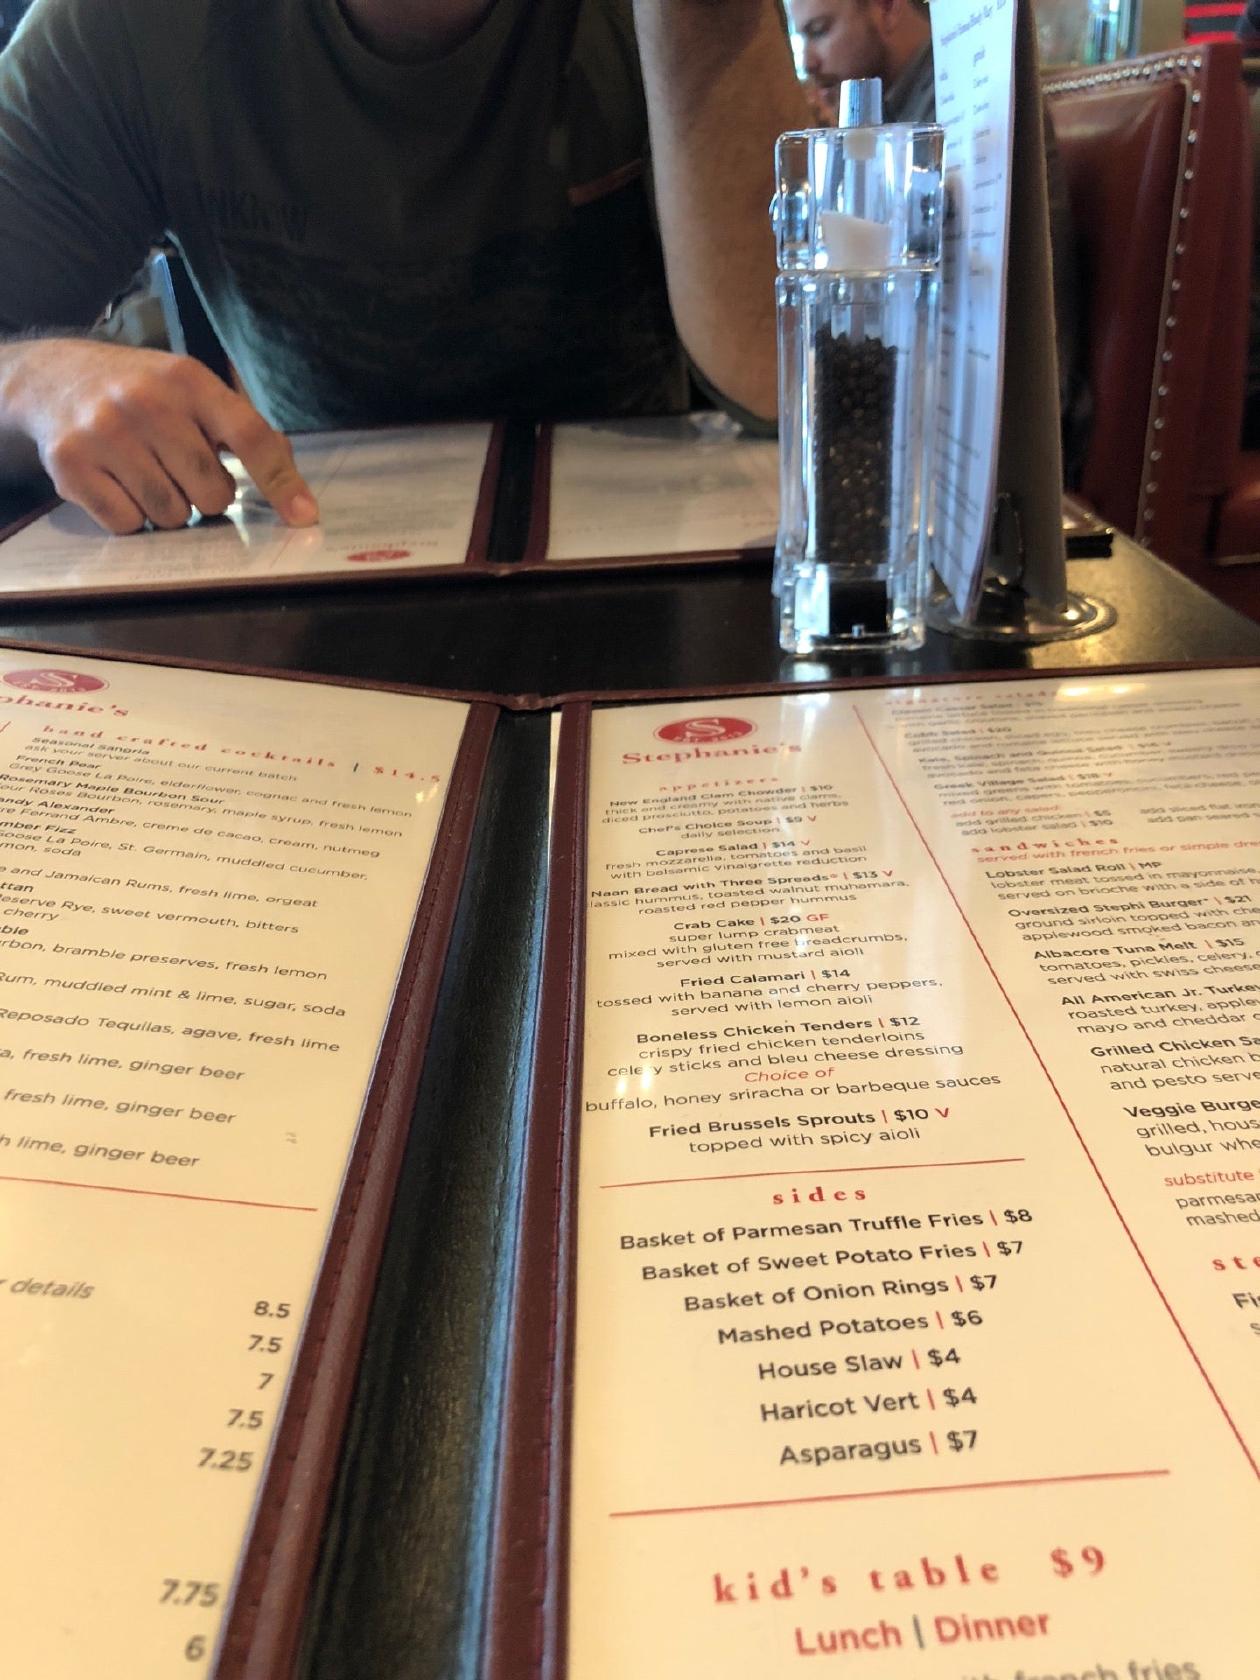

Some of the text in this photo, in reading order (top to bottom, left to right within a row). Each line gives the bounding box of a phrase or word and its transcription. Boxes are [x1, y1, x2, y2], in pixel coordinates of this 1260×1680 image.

[43, 725, 103, 738] hand
[116, 736, 207, 751] crafted
[16, 755, 65, 766] French
[622, 743, 801, 764] Stephanie's
[0, 773, 222, 804] Rosemary Maple Bourbon Sour
[685, 822, 732, 830] Choice
[656, 847, 714, 856] Caprese
[718, 843, 758, 851] Salad
[971, 838, 1118, 852] sandwiches
[985, 861, 1162, 878] Lobster Salad Roll MP
[10, 868, 317, 907] and Jamaican Rums, fresh lime, orgeat
[634, 884, 677, 894] Bread
[683, 881, 715, 890] with
[852, 871, 878, 879] $13
[60, 900, 95, 913] Rye,
[101, 907, 150, 918] sweet
[157, 913, 239, 927] vermouth,
[245, 920, 298, 933] bitters
[1008, 905, 1089, 917] Oversized
[1093, 901, 1145, 912] Stephi
[1224, 895, 1251, 904] $21
[673, 913, 828, 930] Crab Cake $20 GF
[1034, 938, 1244, 959] Albacore Tuna Melt $15
[680, 969, 850, 987] Fried Calamari $14
[44, 979, 127, 993] muddled
[130, 987, 172, 998] mint
[177, 990, 190, 999] &
[196, 991, 236, 1005] lime,
[243, 997, 296, 1011] sugar,
[303, 1004, 345, 1016] soda
[1062, 995, 1085, 1005] All
[1091, 990, 1176, 1003] American
[1182, 988, 1202, 997] Jr.
[98, 1017, 174, 1034] Tequilas,
[181, 1027, 241, 1041] agave,
[248, 1032, 294, 1046] fresh
[301, 1038, 339, 1051] lime
[637, 1016, 920, 1043] Boneless Chicken Tenders $12
[1090, 1039, 1236, 1057] Grilled Chicken
[23, 1048, 245, 1080] fresh lime, ginger beer
[744, 1066, 835, 1082] Choice of
[586, 1076, 1000, 1111] buffalo, honey sriracha or barbeque sauces
[1123, 1102, 1196, 1117] Veggie
[649, 1122, 701, 1137] Fried
[708, 1116, 791, 1132] Brussels
[797, 1112, 875, 1128] Sprouts
[894, 1109, 928, 1122] $10
[16, 1136, 200, 1166] lime, ginger beer
[689, 1127, 920, 1153] topped with spicy aioli
[1164, 1170, 1254, 1186] substitute
[773, 1186, 865, 1204] sides
[620, 1209, 1032, 1249] Basket of Parmesan Truffle Fries $8
[642, 1240, 1022, 1280] Basket of Sweet Potato Fries $7
[10, 1277, 95, 1299] details
[684, 1274, 997, 1311] Basket of Onion Rings $7
[254, 1300, 290, 1318] 8.5
[718, 1310, 983, 1344] Mashed Potatoes $6
[248, 1334, 282, 1354] 7.5
[758, 1348, 961, 1380] House Slaw $4
[258, 1372, 274, 1390] 7
[760, 1387, 977, 1422] Haricot Vert $4
[227, 1408, 263, 1430] 7.5
[198, 1447, 253, 1472] 7.25
[780, 1429, 977, 1466] Asparagus $7
[713, 1567, 837, 1603] kid's
[869, 1554, 998, 1591] table
[159, 1578, 218, 1607] 7.75
[794, 1614, 1048, 1656] Lunch Dinner
[184, 1635, 205, 1662] 6
